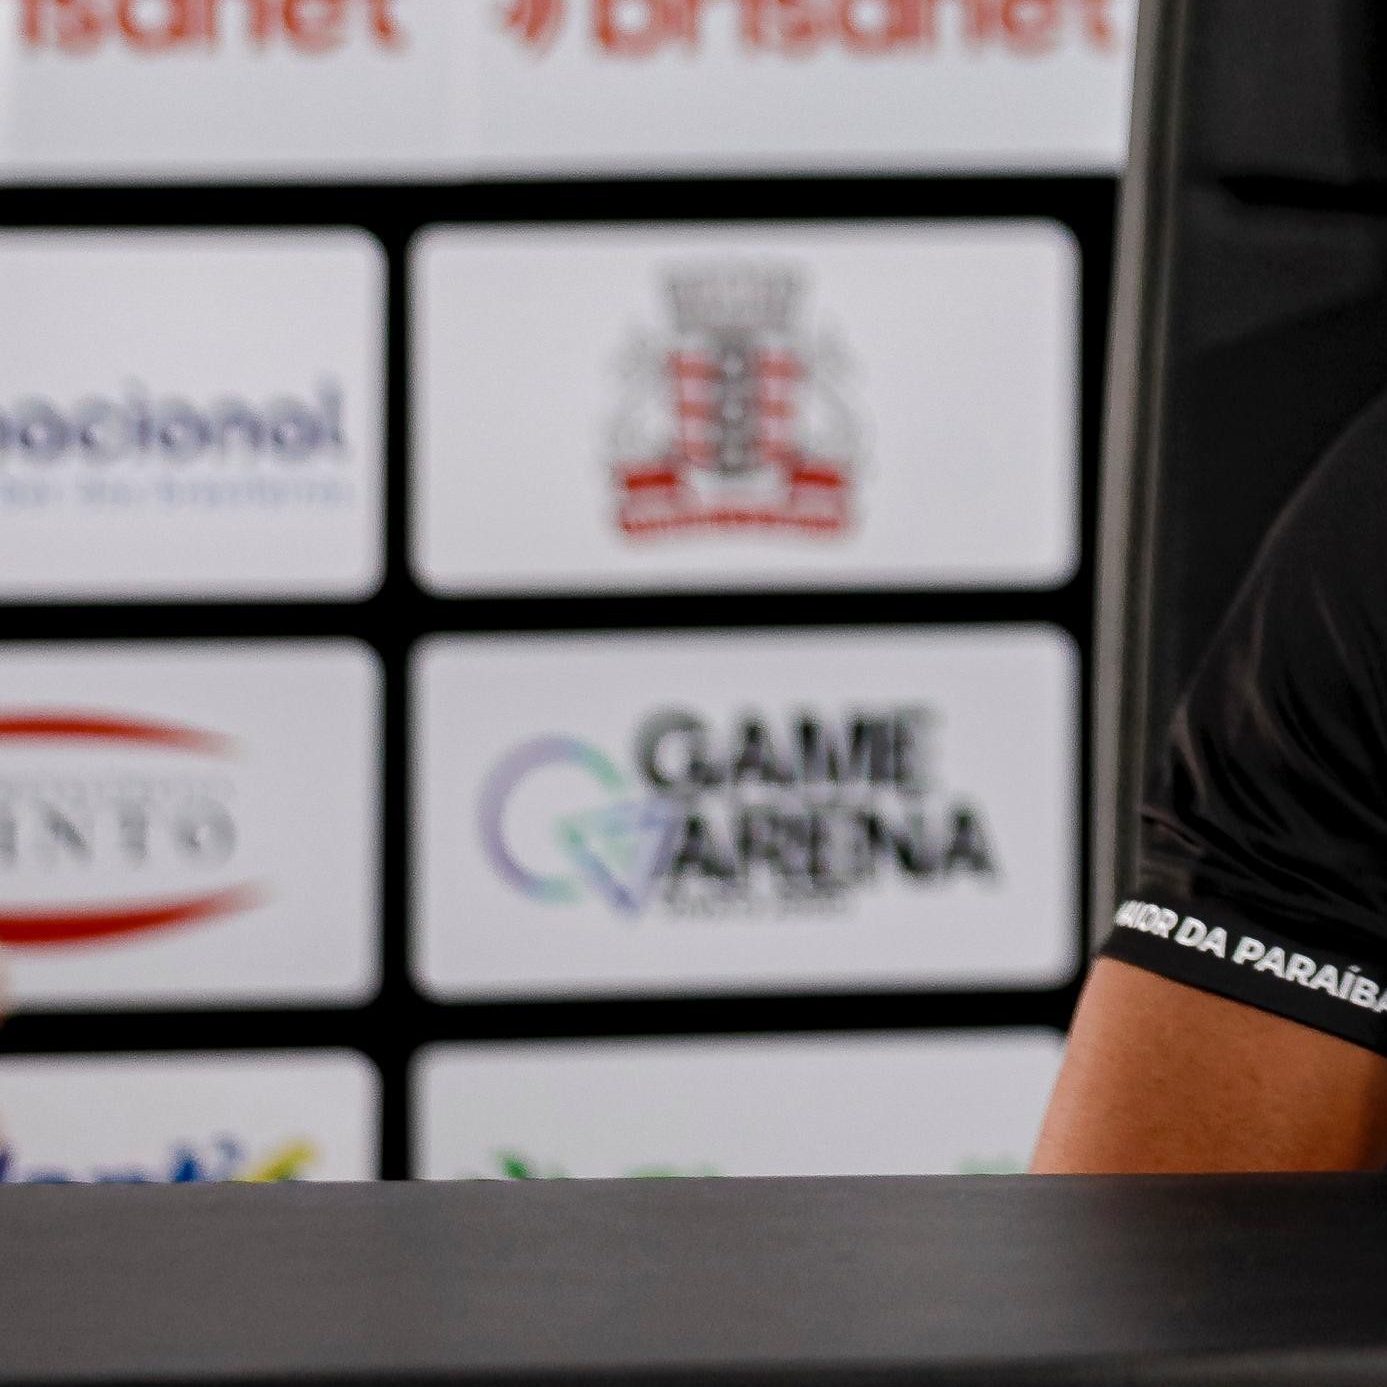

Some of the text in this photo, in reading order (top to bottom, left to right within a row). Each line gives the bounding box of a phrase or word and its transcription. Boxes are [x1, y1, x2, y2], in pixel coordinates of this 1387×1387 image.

[636, 705, 938, 795] GAME
[672, 800, 997, 887] ARENA
[1174, 915, 1228, 959] DA
